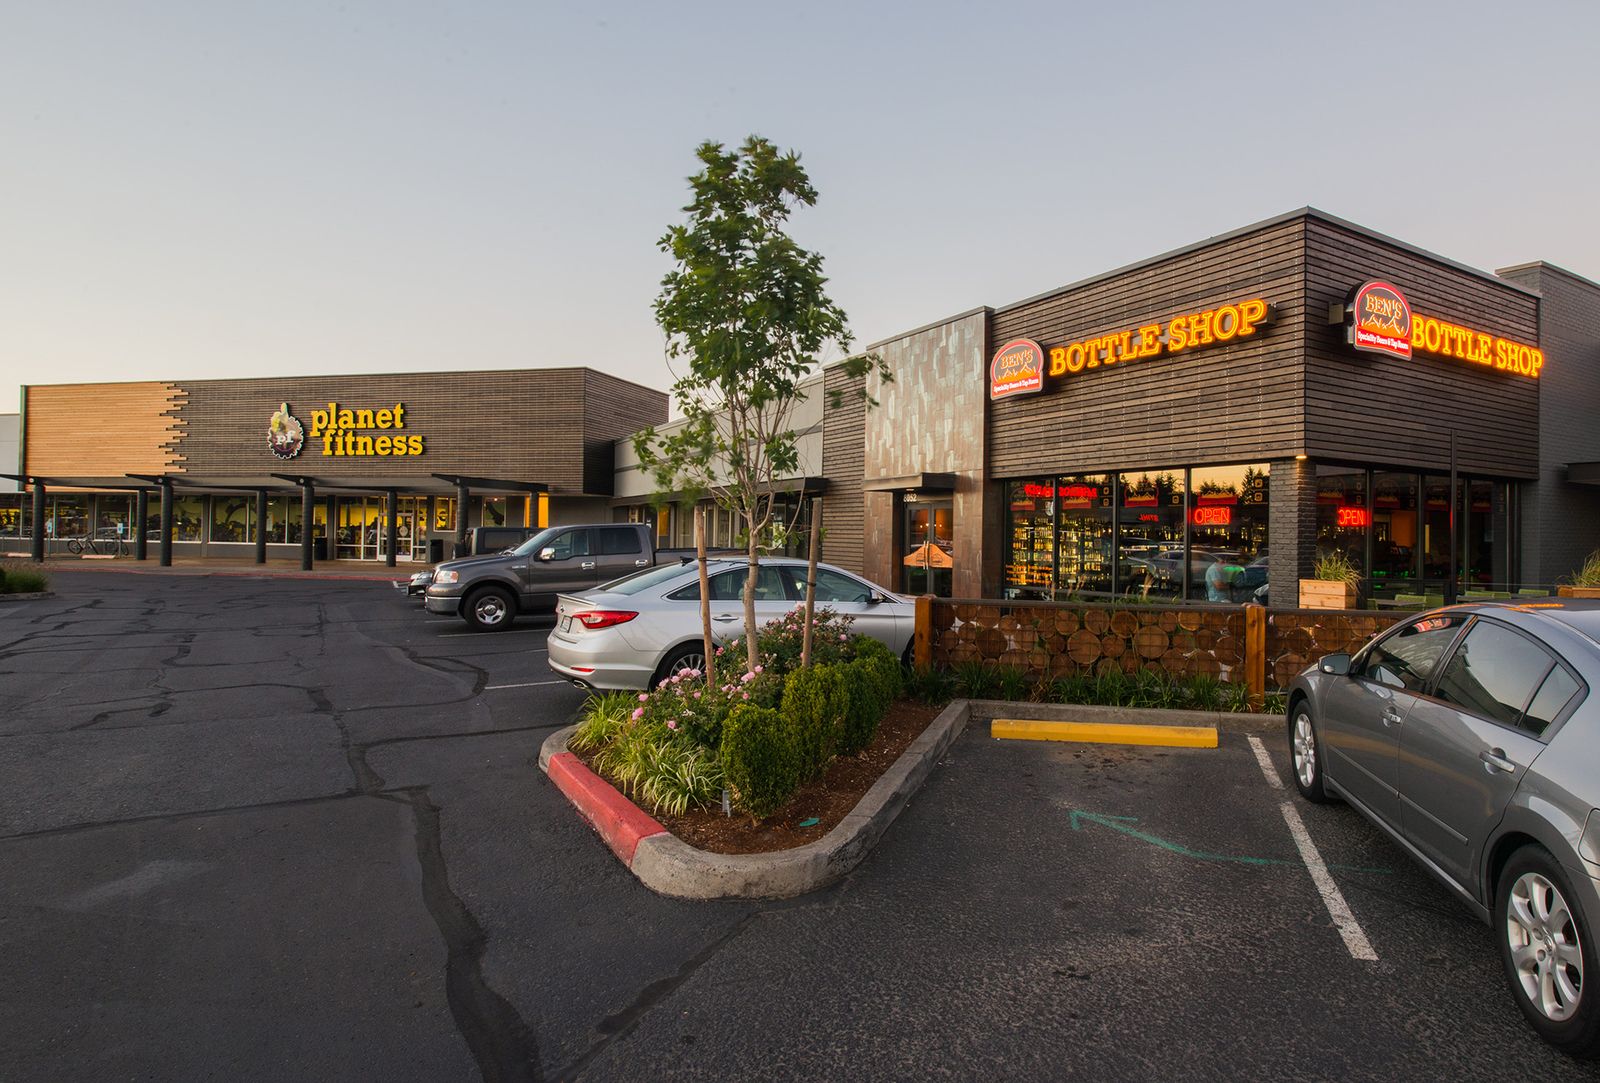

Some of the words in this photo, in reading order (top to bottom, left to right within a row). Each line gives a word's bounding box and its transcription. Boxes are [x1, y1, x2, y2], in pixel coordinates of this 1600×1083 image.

[1365, 293, 1403, 320] BEN'S
[1049, 324, 1163, 376] BOTTLE
[1167, 299, 1268, 351] SHOP
[1411, 315, 1493, 366] BOTTLE
[1496, 337, 1544, 378] SHOP
[1000, 349, 1033, 369] BEN'S
[309, 402, 404, 437] planet
[275, 430, 296, 445] pf
[322, 429, 424, 456] fitness
[1194, 507, 1230, 524] OPEN
[1337, 509, 1364, 526] OPEN
